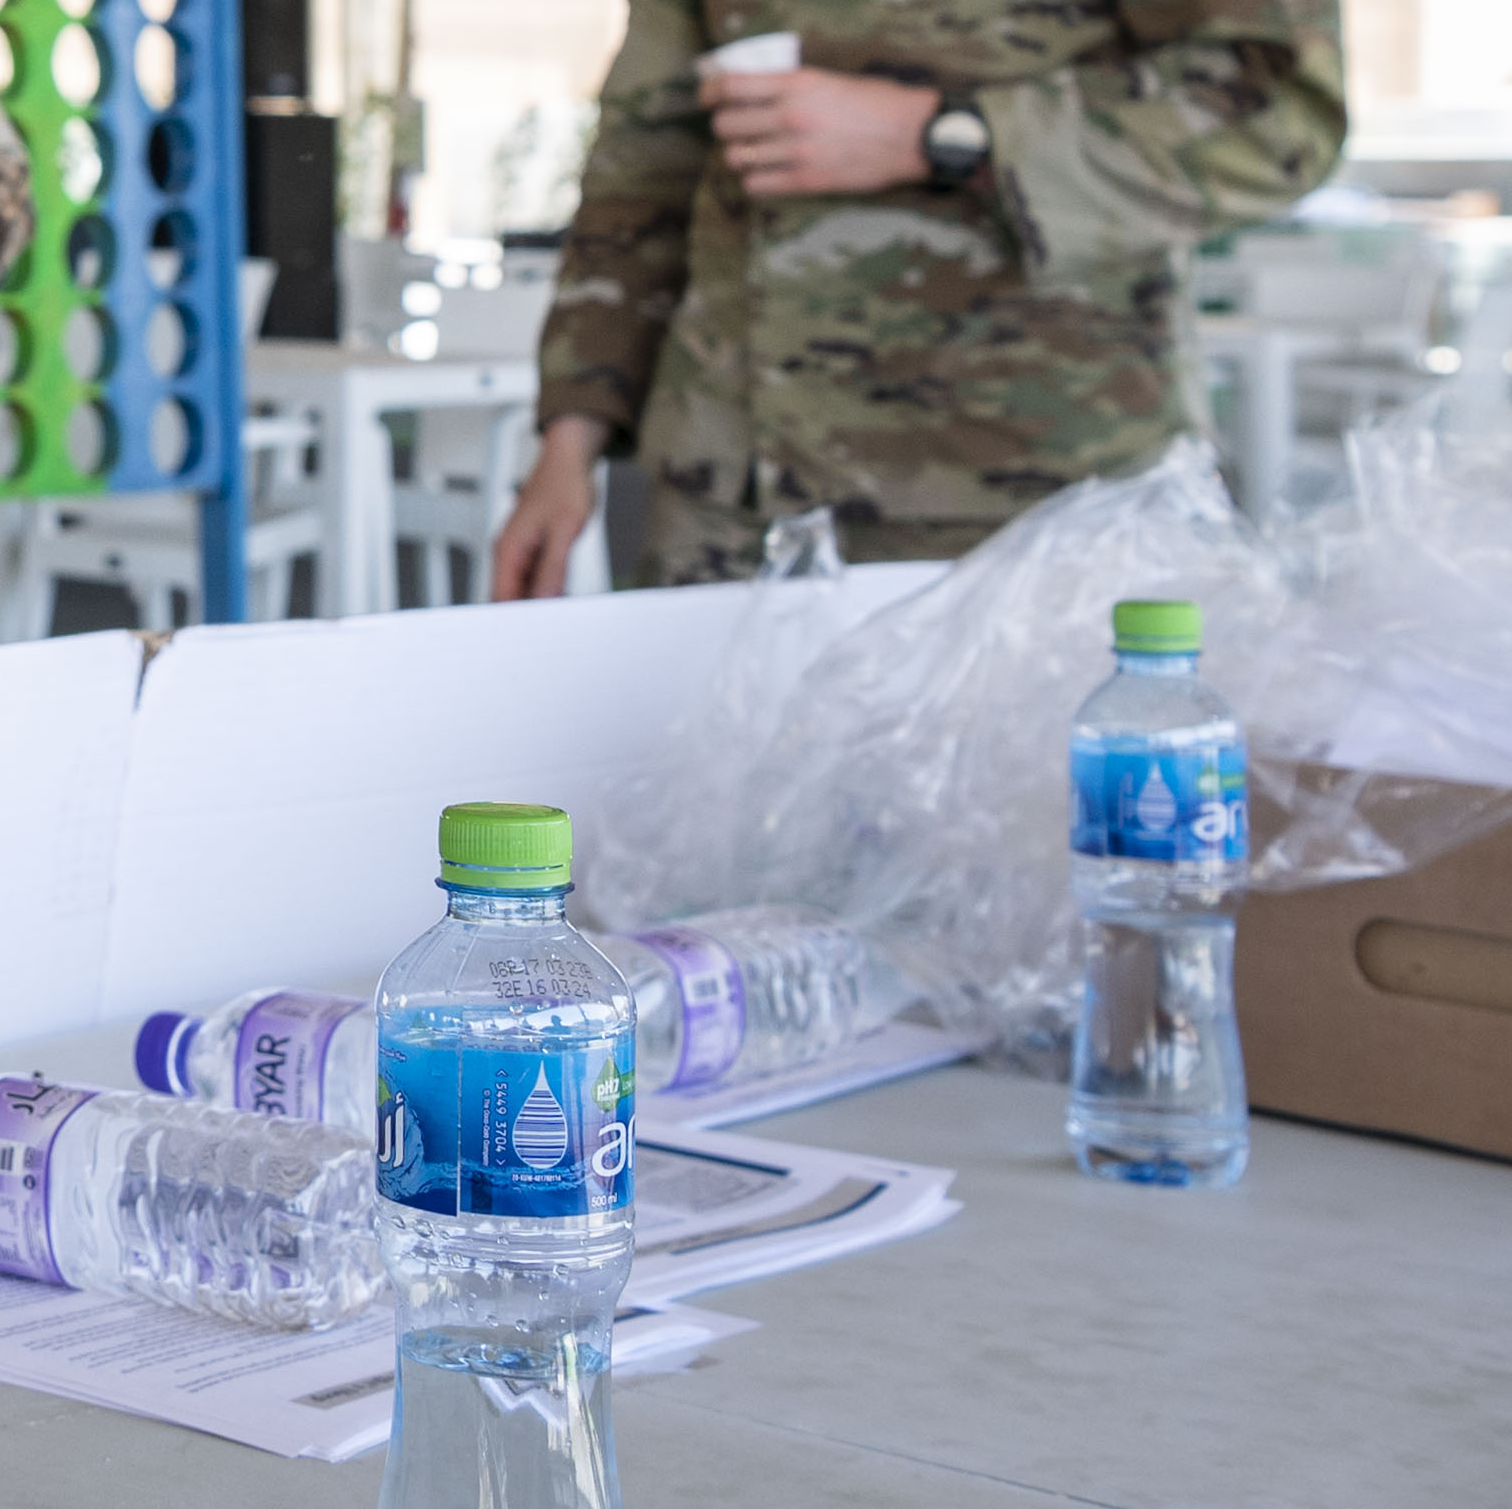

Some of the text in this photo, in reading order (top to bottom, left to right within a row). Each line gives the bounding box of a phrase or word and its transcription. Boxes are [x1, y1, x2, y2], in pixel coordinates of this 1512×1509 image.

[522, 958, 539, 976] 17
[527, 979, 547, 996] 16
[495, 1083, 508, 1115] 5449
[597, 1078, 620, 1102] pH7
[495, 1120, 508, 1153] 3704
[591, 1192, 618, 1208] 500 ml
